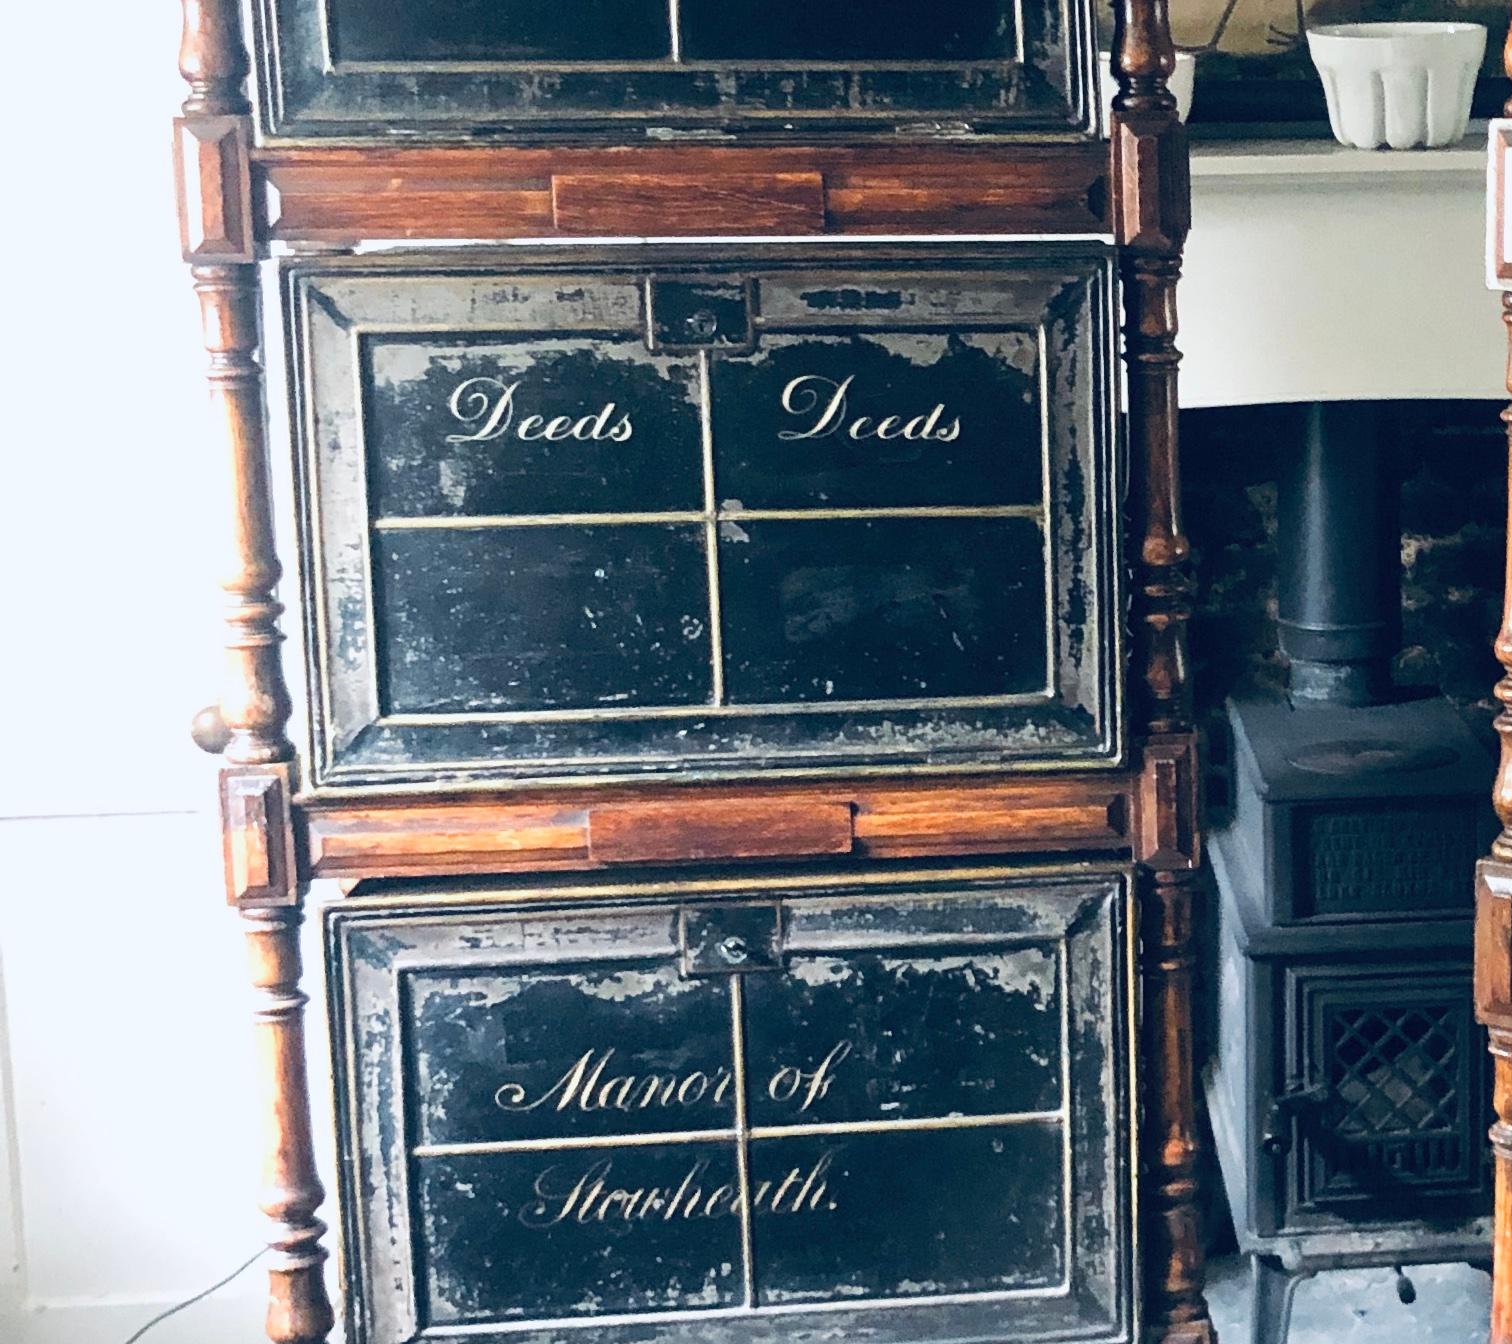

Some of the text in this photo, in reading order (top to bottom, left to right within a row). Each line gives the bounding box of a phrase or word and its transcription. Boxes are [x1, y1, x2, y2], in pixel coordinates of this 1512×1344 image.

[445, 375, 633, 444] Deeds
[777, 373, 963, 443] Deeds
[494, 1038, 854, 1113] Manor of
